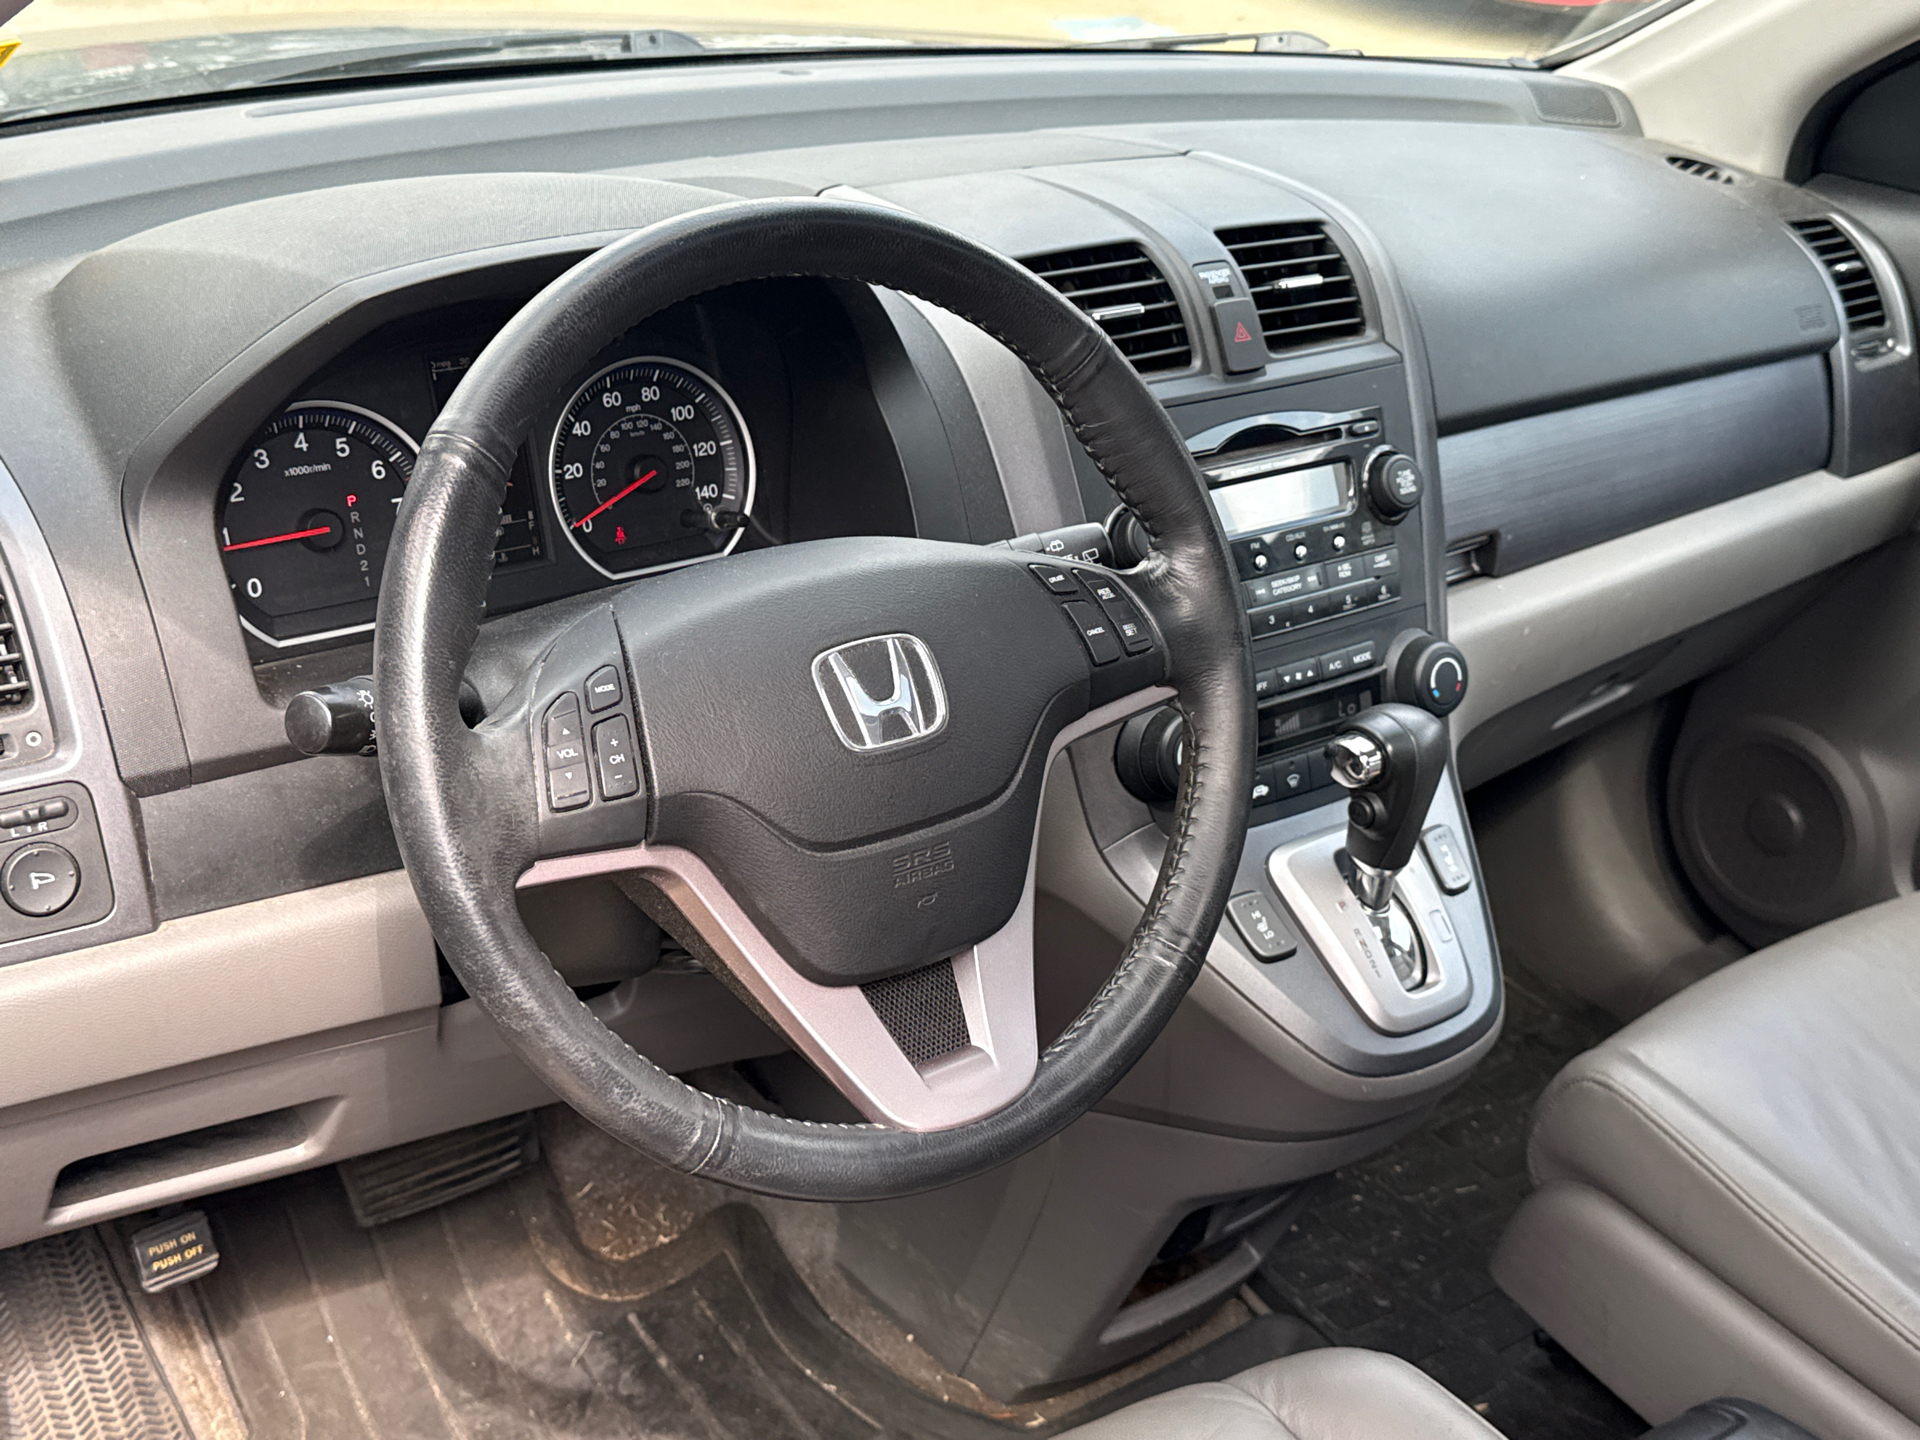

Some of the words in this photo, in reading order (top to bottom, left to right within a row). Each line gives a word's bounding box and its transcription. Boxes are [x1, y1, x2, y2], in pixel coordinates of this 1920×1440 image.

[602, 391, 622, 408] 60
[641, 385, 660, 402] 80
[625, 403, 642, 413] mph
[671, 404, 695, 422] 100
[572, 420, 591, 437] 40
[621, 421, 634, 431] 100
[636, 419, 649, 429] 120
[650, 422, 663, 432] 140
[609, 430, 620, 440] 80
[294, 432, 309, 452] 4
[335, 437, 350, 457] 5
[692, 440, 716, 457] 120
[254, 449, 270, 469] 3
[595, 461, 606, 470] 40
[675, 461, 690, 470] 200
[371, 460, 386, 480] 6
[563, 462, 583, 480] 20
[596, 479, 607, 488] 20
[675, 478, 690, 488] 220
[230, 483, 245, 502] 2
[695, 483, 718, 500] 140
[346, 494, 357, 507] P
[351, 511, 361, 523] R
[582, 518, 593, 533] 0
[222, 527, 231, 547] 1
[353, 527, 364, 539] N
[356, 543, 367, 555] D
[360, 560, 369, 571] 2
[246, 578, 263, 598] 0
[1307, 605, 1314, 613] 4
[1268, 615, 1275, 625] 3
[1353, 651, 1372, 664] MODE
[1329, 660, 1343, 671] A/C
[1256, 681, 1268, 692] FF
[556, 748, 579, 760] VOL
[609, 753, 625, 765] CH
[10, 828, 20, 838] L
[38, 821, 48, 832] R
[893, 841, 951, 873] SRS
[894, 860, 955, 889] AIRBAG
[148, 1238, 178, 1257] PUSH
[180, 1231, 196, 1245] ON
[152, 1253, 182, 1272] PUSH
[184, 1244, 204, 1259] OFF
